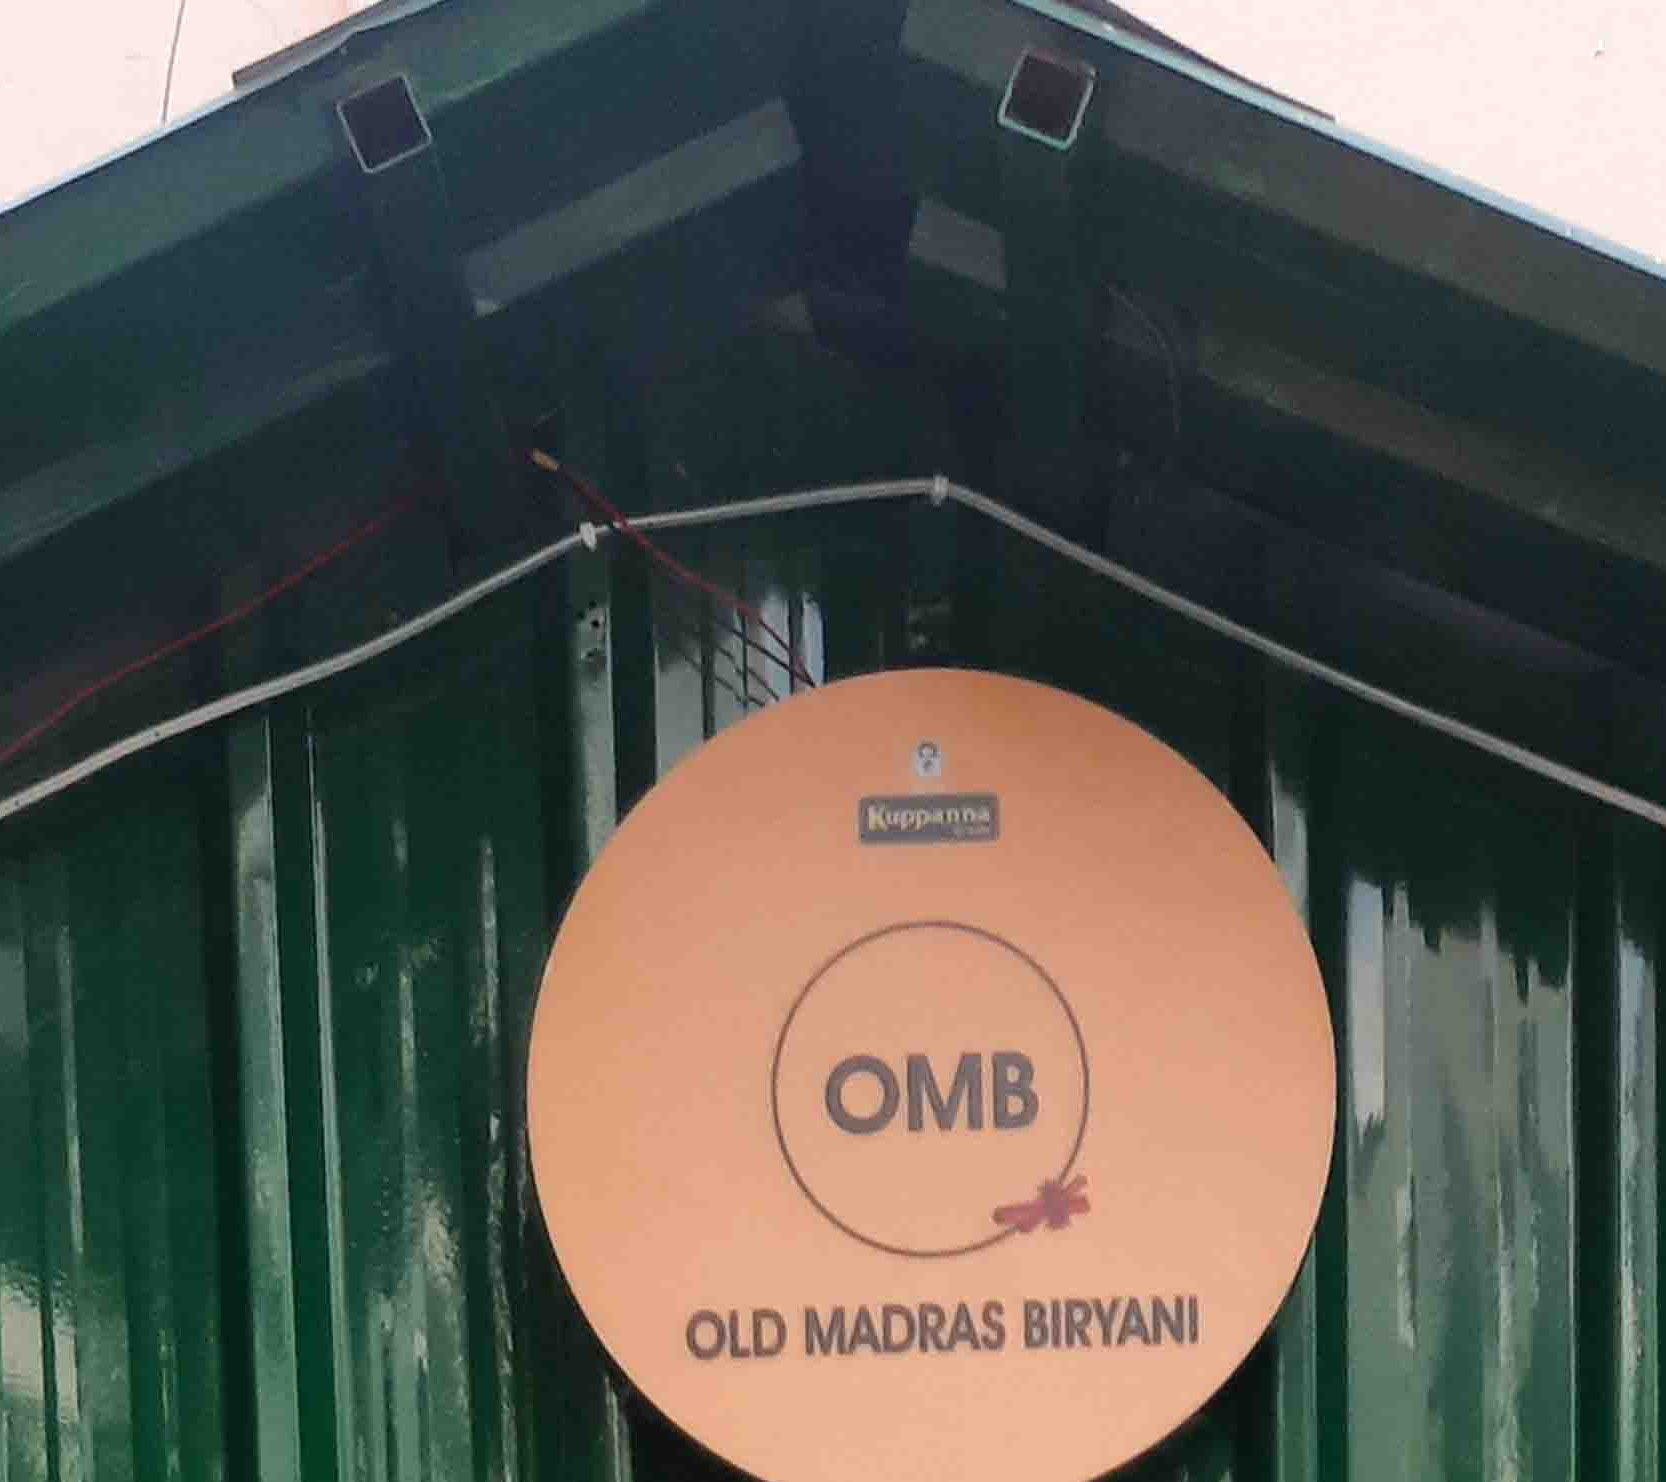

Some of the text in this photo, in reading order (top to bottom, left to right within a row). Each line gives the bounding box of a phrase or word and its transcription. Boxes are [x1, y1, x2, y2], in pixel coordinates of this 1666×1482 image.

[824, 1052, 1039, 1135] OMB
[685, 1295, 1199, 1360] OLD MADRAS BIRYANI
